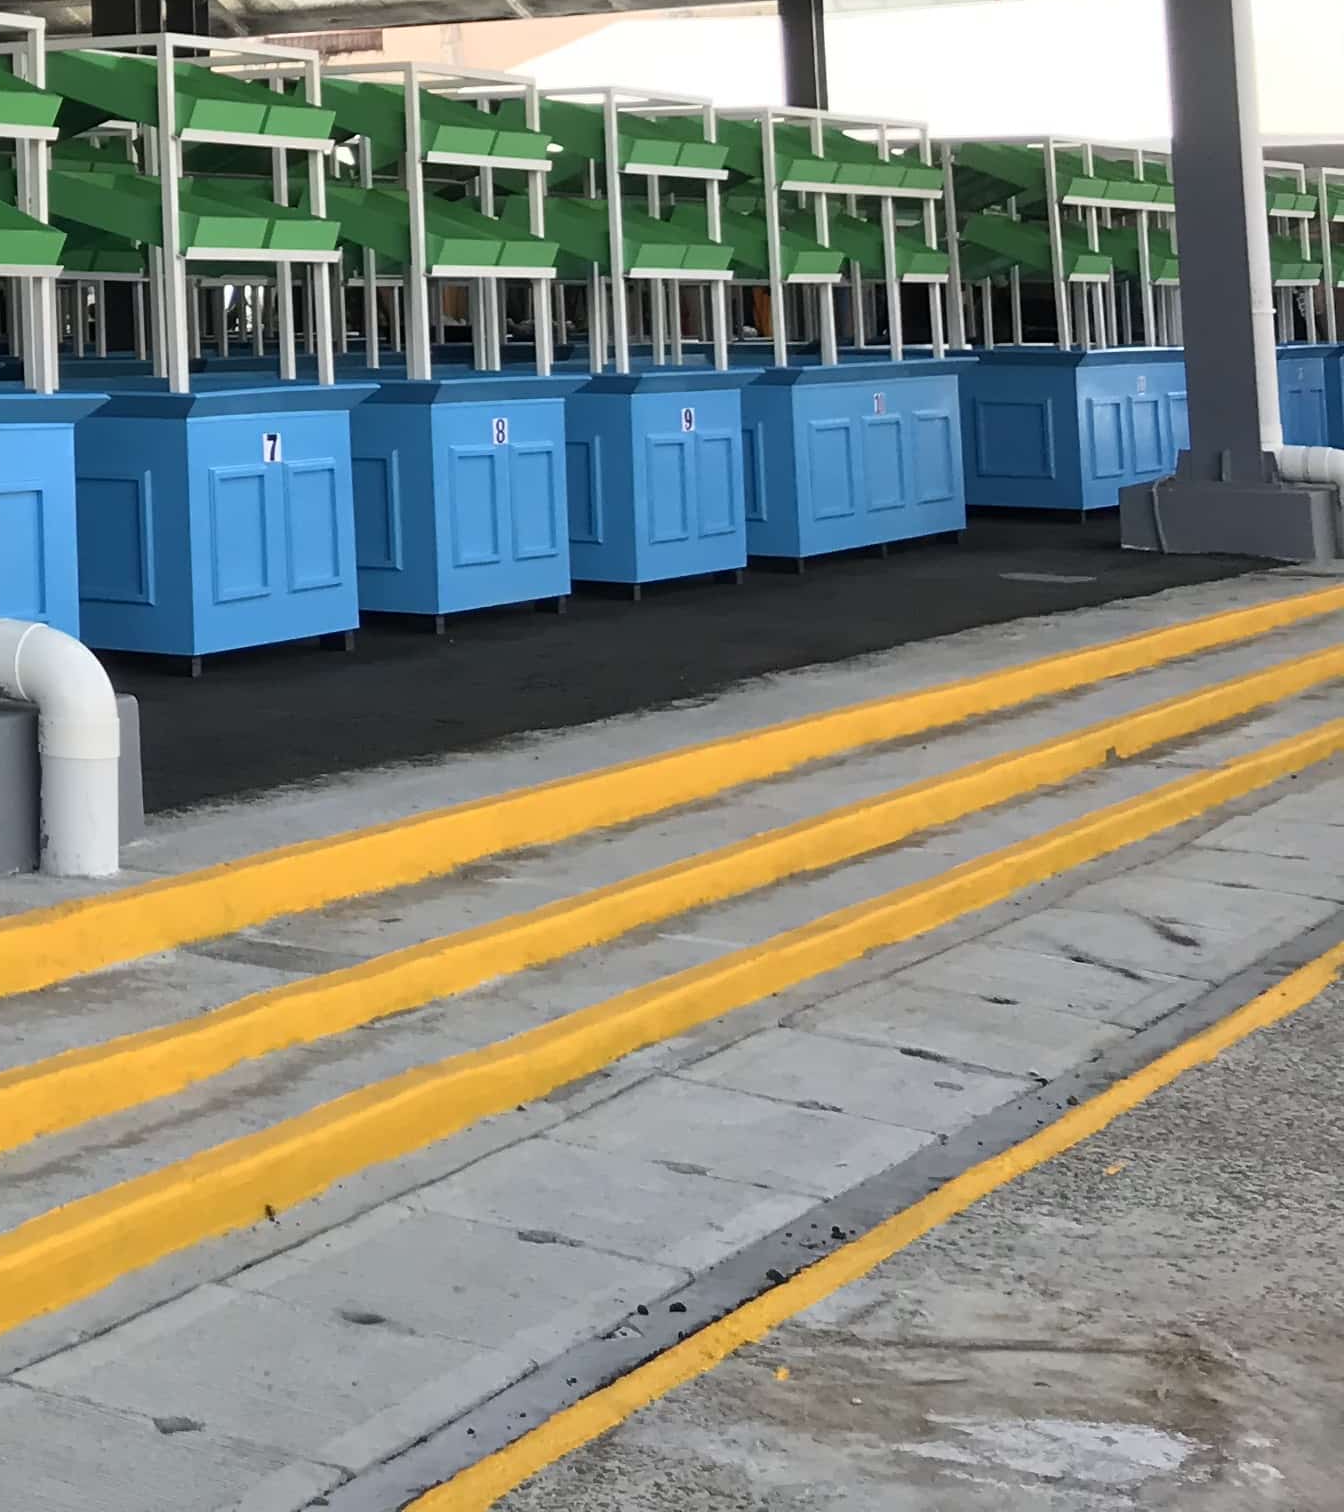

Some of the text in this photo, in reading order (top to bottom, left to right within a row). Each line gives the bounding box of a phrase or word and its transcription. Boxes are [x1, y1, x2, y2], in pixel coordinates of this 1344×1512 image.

[496, 419, 505, 444] 8
[684, 408, 693, 431] 9
[267, 434, 277, 461] 7
